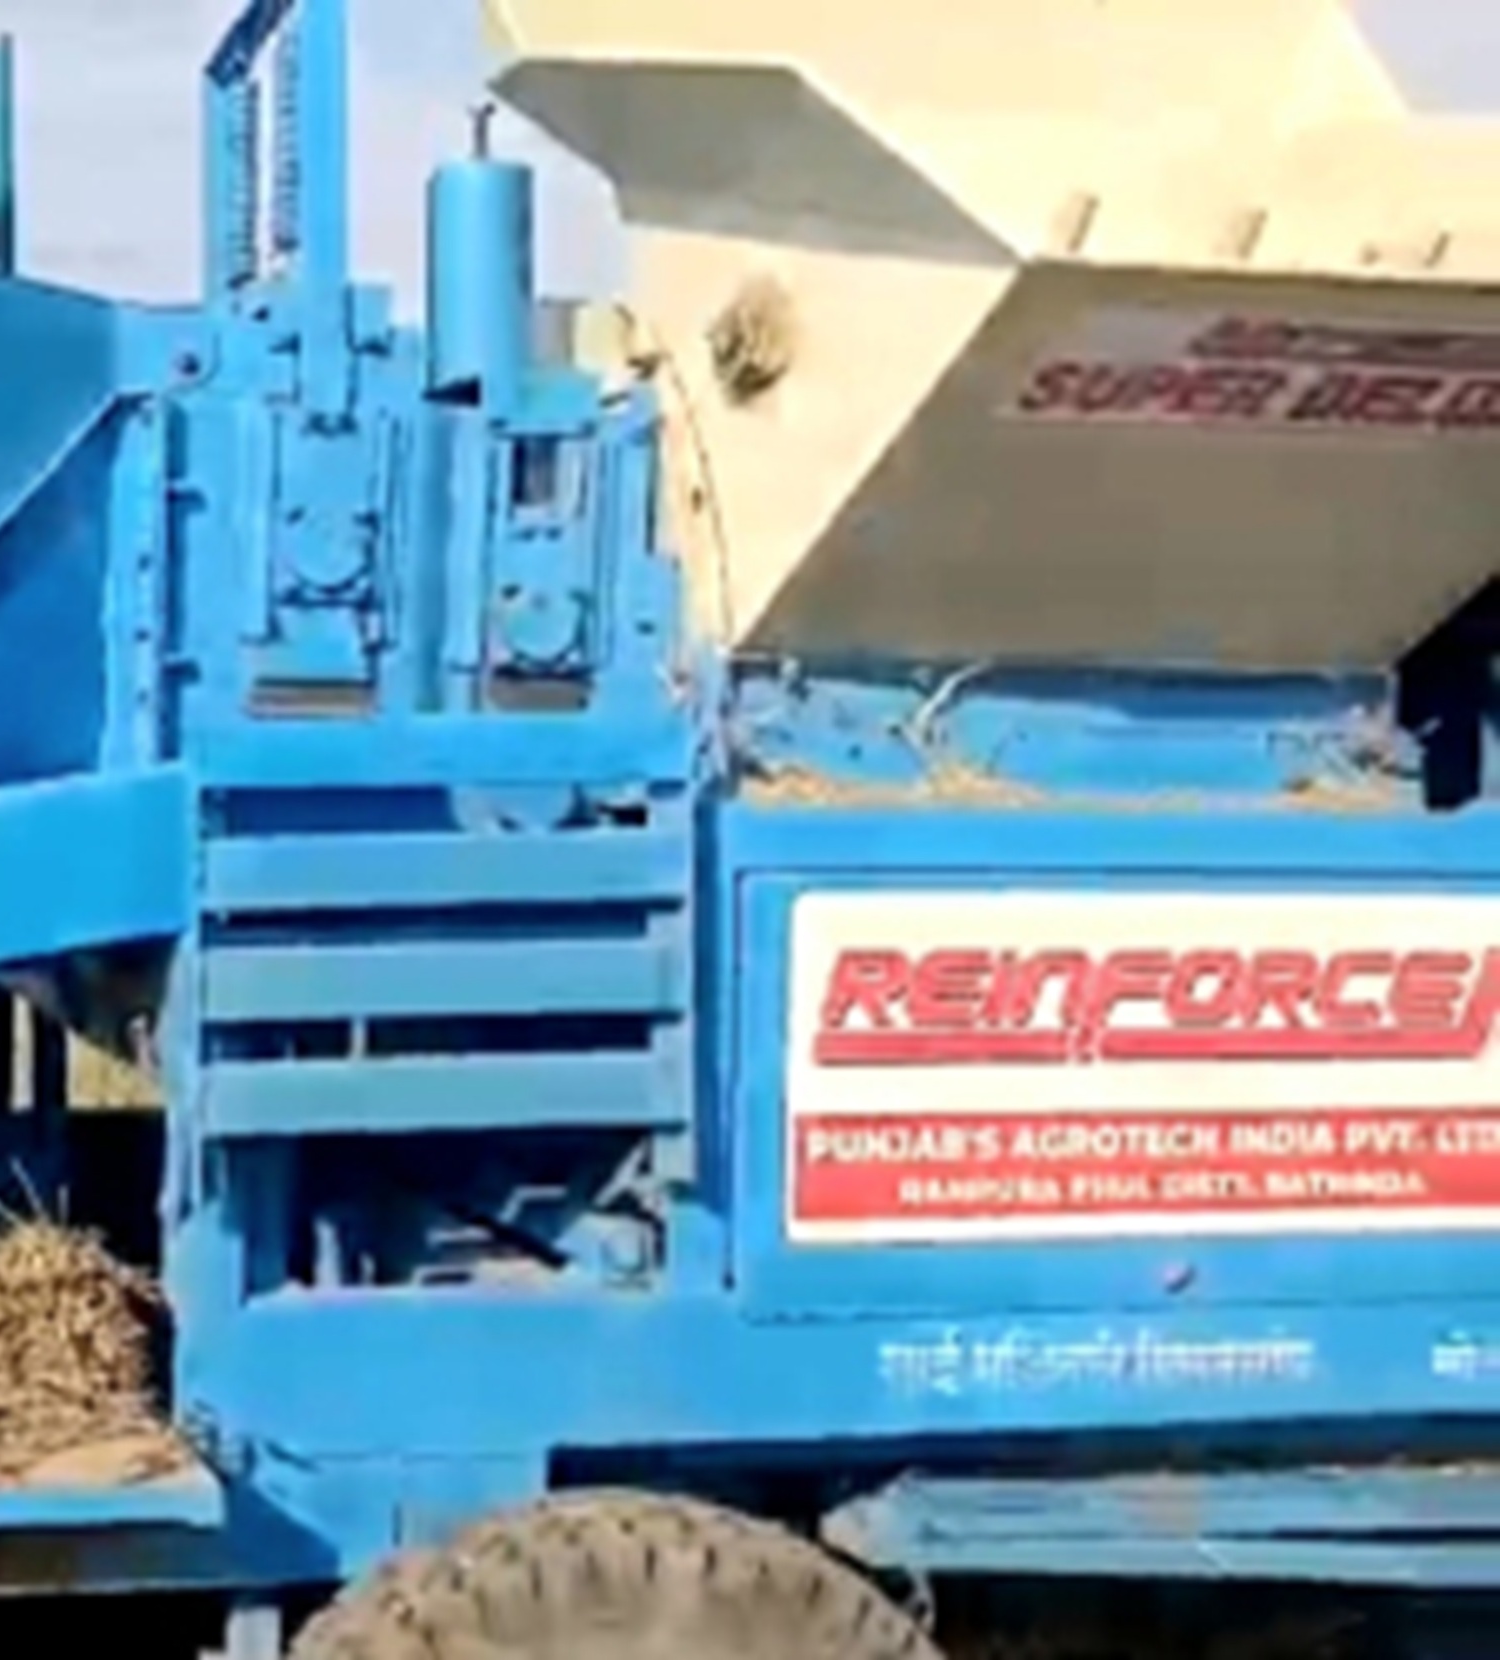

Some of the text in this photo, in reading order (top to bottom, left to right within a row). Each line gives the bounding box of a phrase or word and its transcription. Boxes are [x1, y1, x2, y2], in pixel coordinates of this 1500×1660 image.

[1017, 361, 1288, 419] SUPER
[806, 1126, 1001, 1164] PUNJAB'S
[1011, 1122, 1219, 1160] AGROTECH
[1230, 1120, 1336, 1155] INDIA
[1345, 1118, 1425, 1153] PVT.
